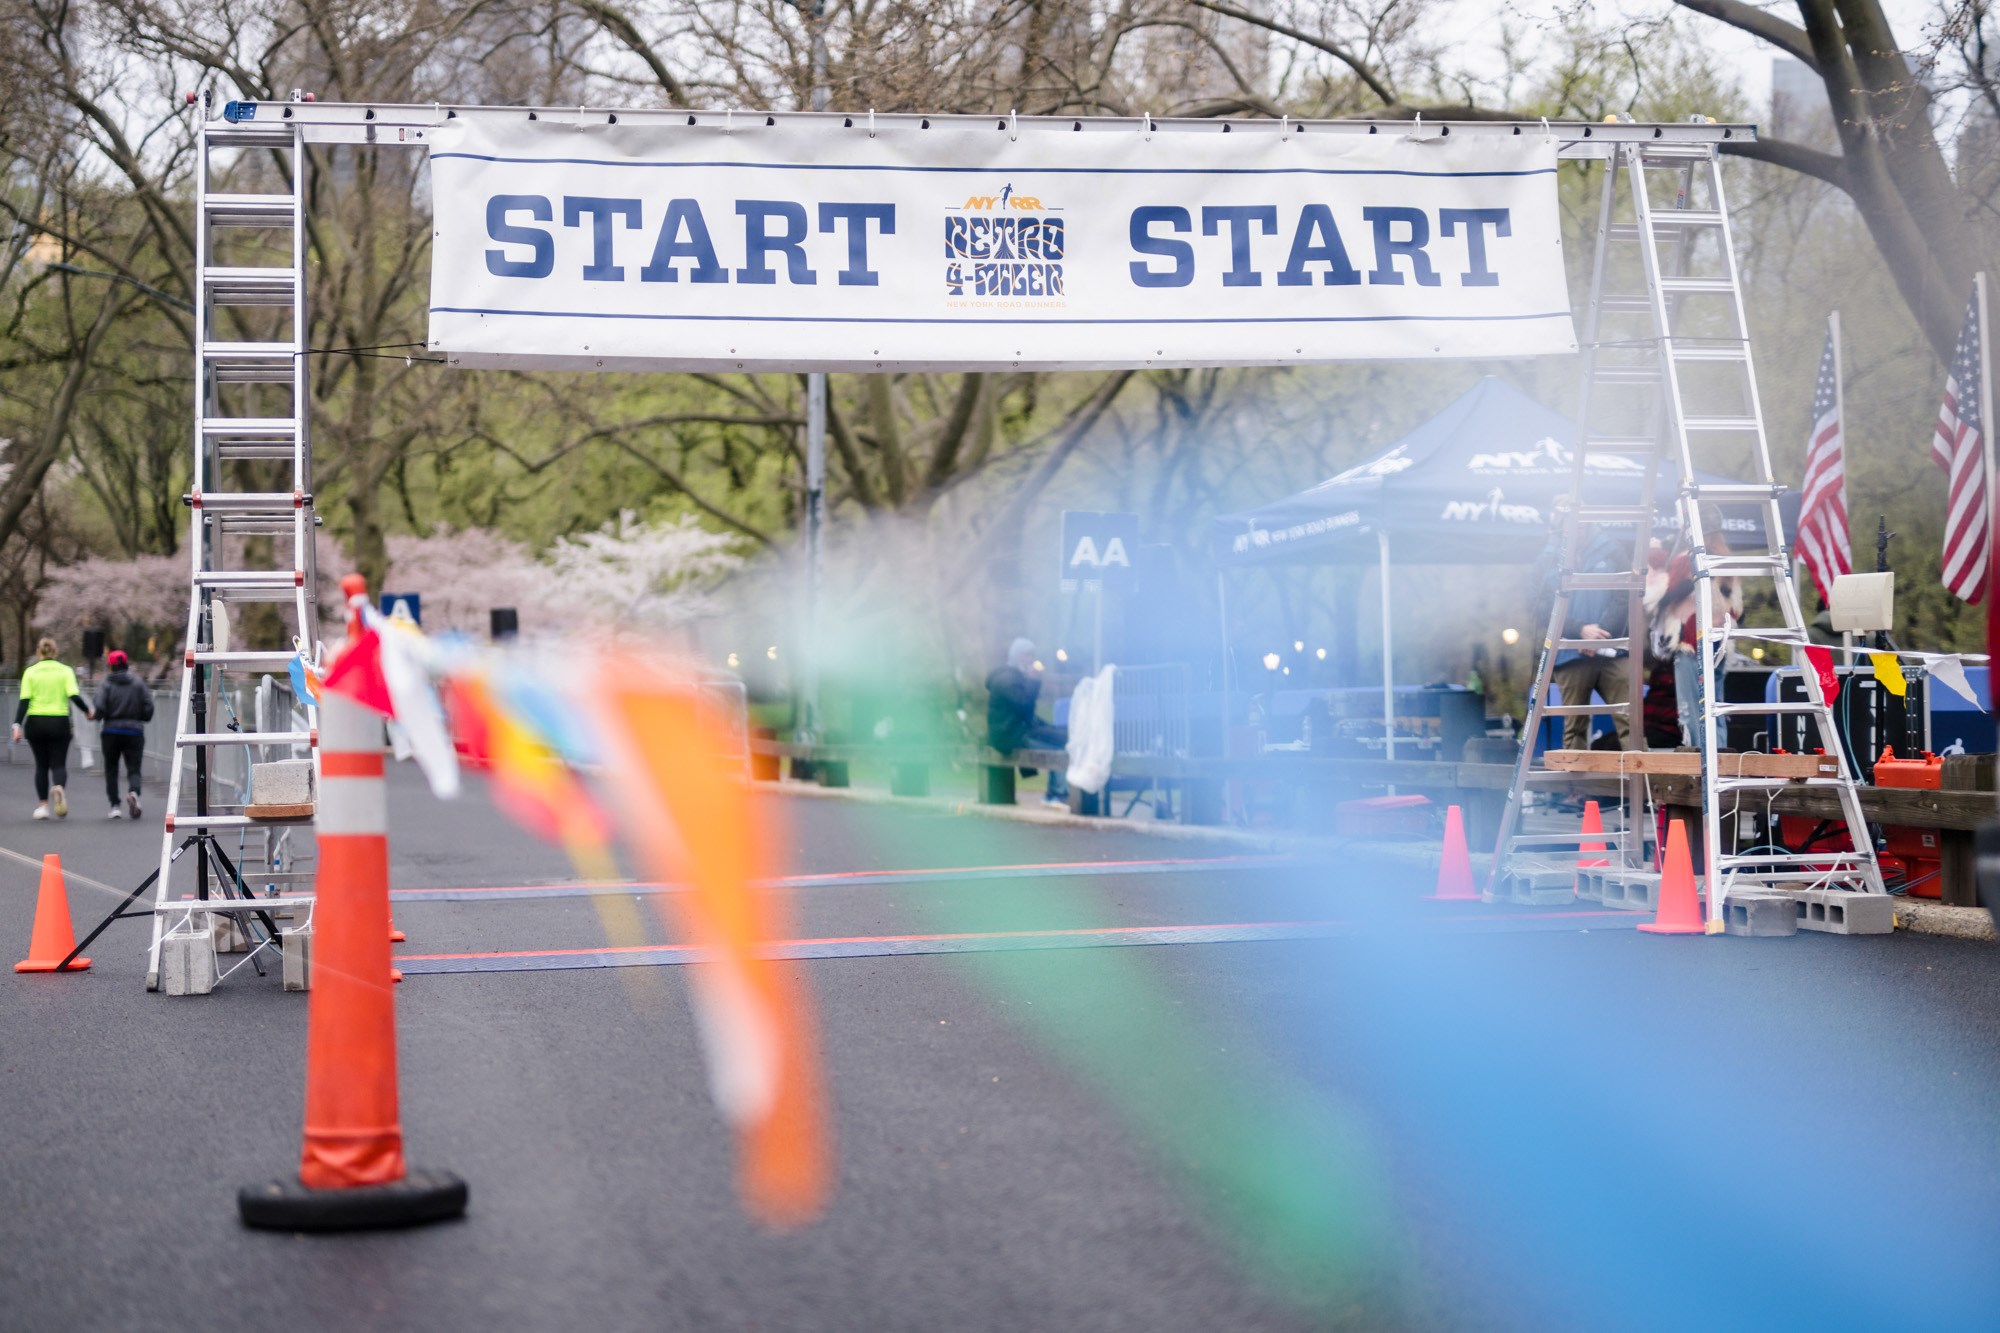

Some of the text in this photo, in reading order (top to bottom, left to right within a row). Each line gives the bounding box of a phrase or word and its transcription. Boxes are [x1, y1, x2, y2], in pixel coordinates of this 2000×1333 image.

[963, 196, 1046, 210] NYRR
[485, 194, 897, 287] START
[945, 216, 1064, 260] RETRO
[1129, 203, 1511, 289] START
[946, 262, 1066, 296] 4-MILER
[946, 300, 1067, 308] NEW YORK ROAD RUNNERS
[1441, 500, 1543, 524] NYRR
[1651, 516, 1678, 529] OAD
[1720, 518, 1757, 532] NERS
[1069, 535, 1131, 568] AA
